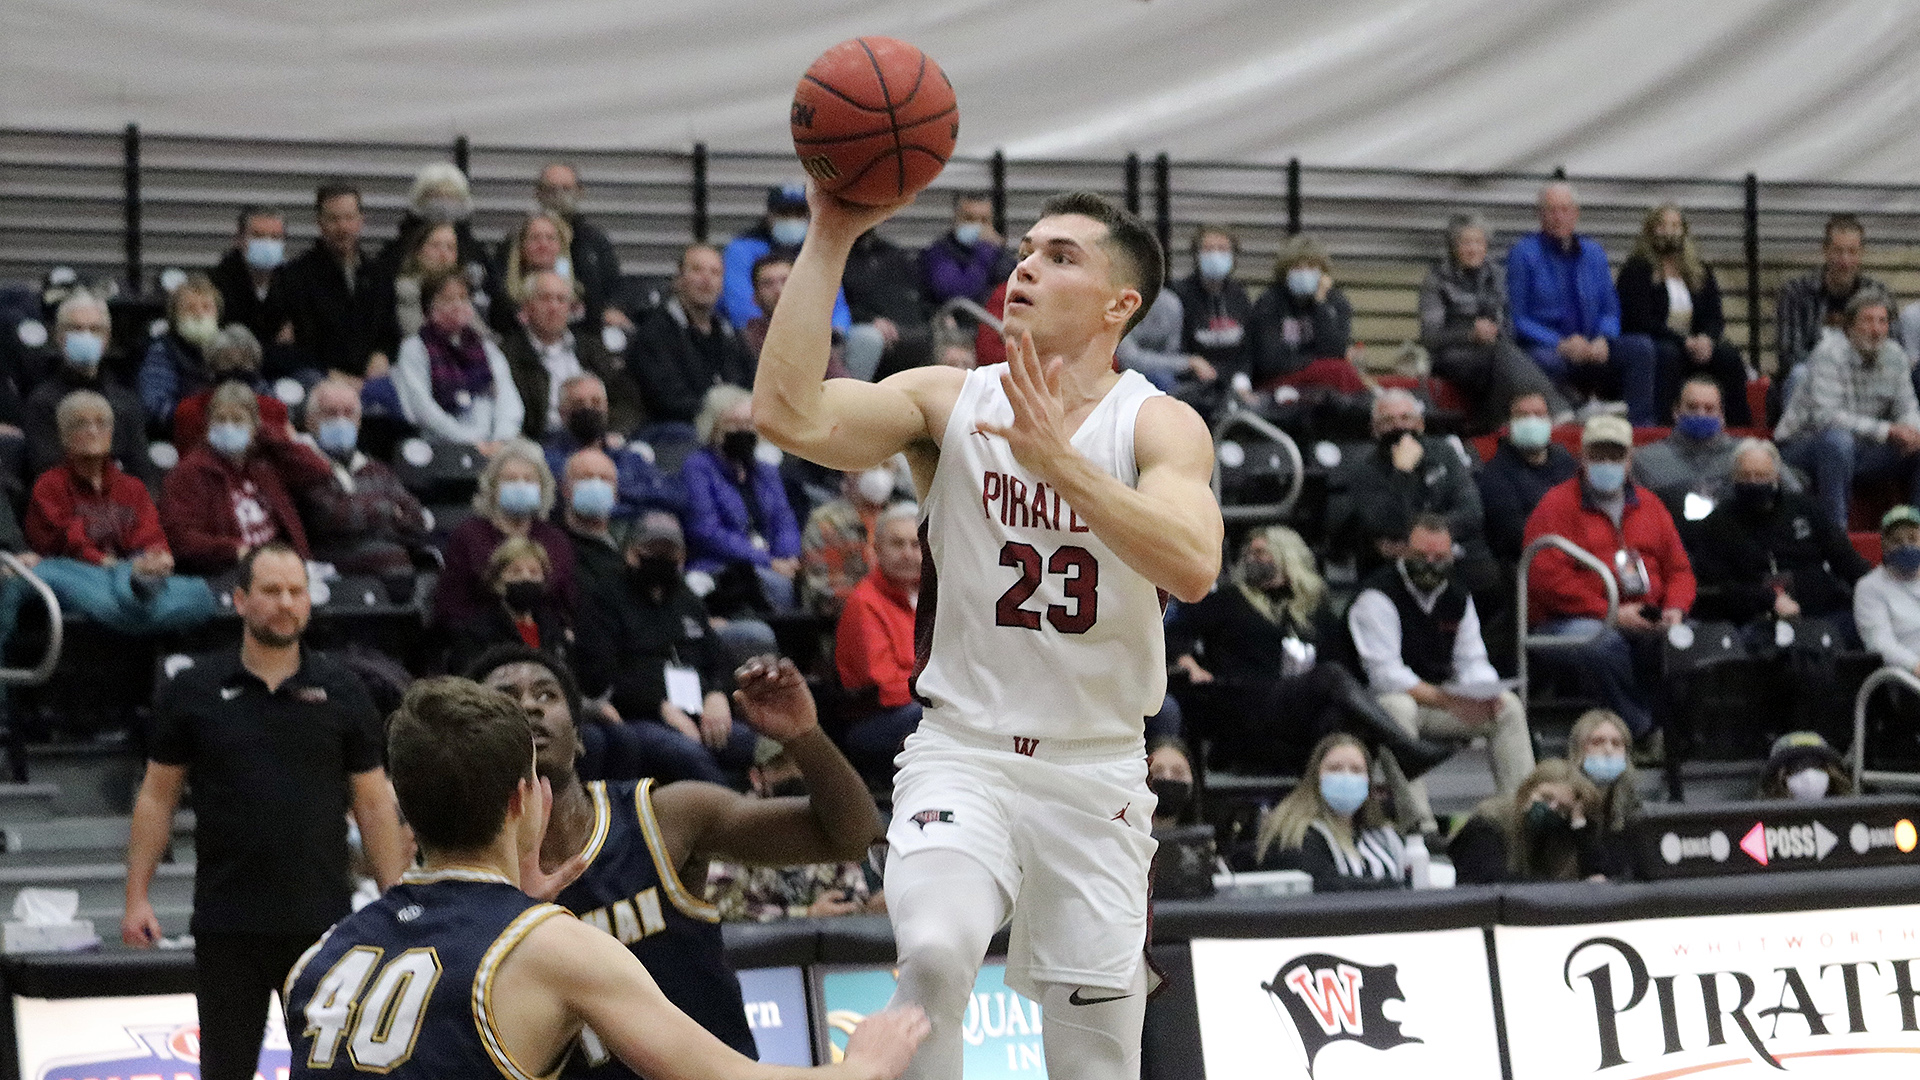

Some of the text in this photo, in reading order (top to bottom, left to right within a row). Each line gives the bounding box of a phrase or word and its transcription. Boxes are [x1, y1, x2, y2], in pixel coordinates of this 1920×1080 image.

[996, 541, 1098, 634] 23
[1013, 736, 1039, 757] W
[1765, 824, 1815, 860] POSS
[1672, 929, 1915, 956] WHITWORTH
[302, 945, 443, 1074] 40
[1285, 963, 1364, 1036] W
